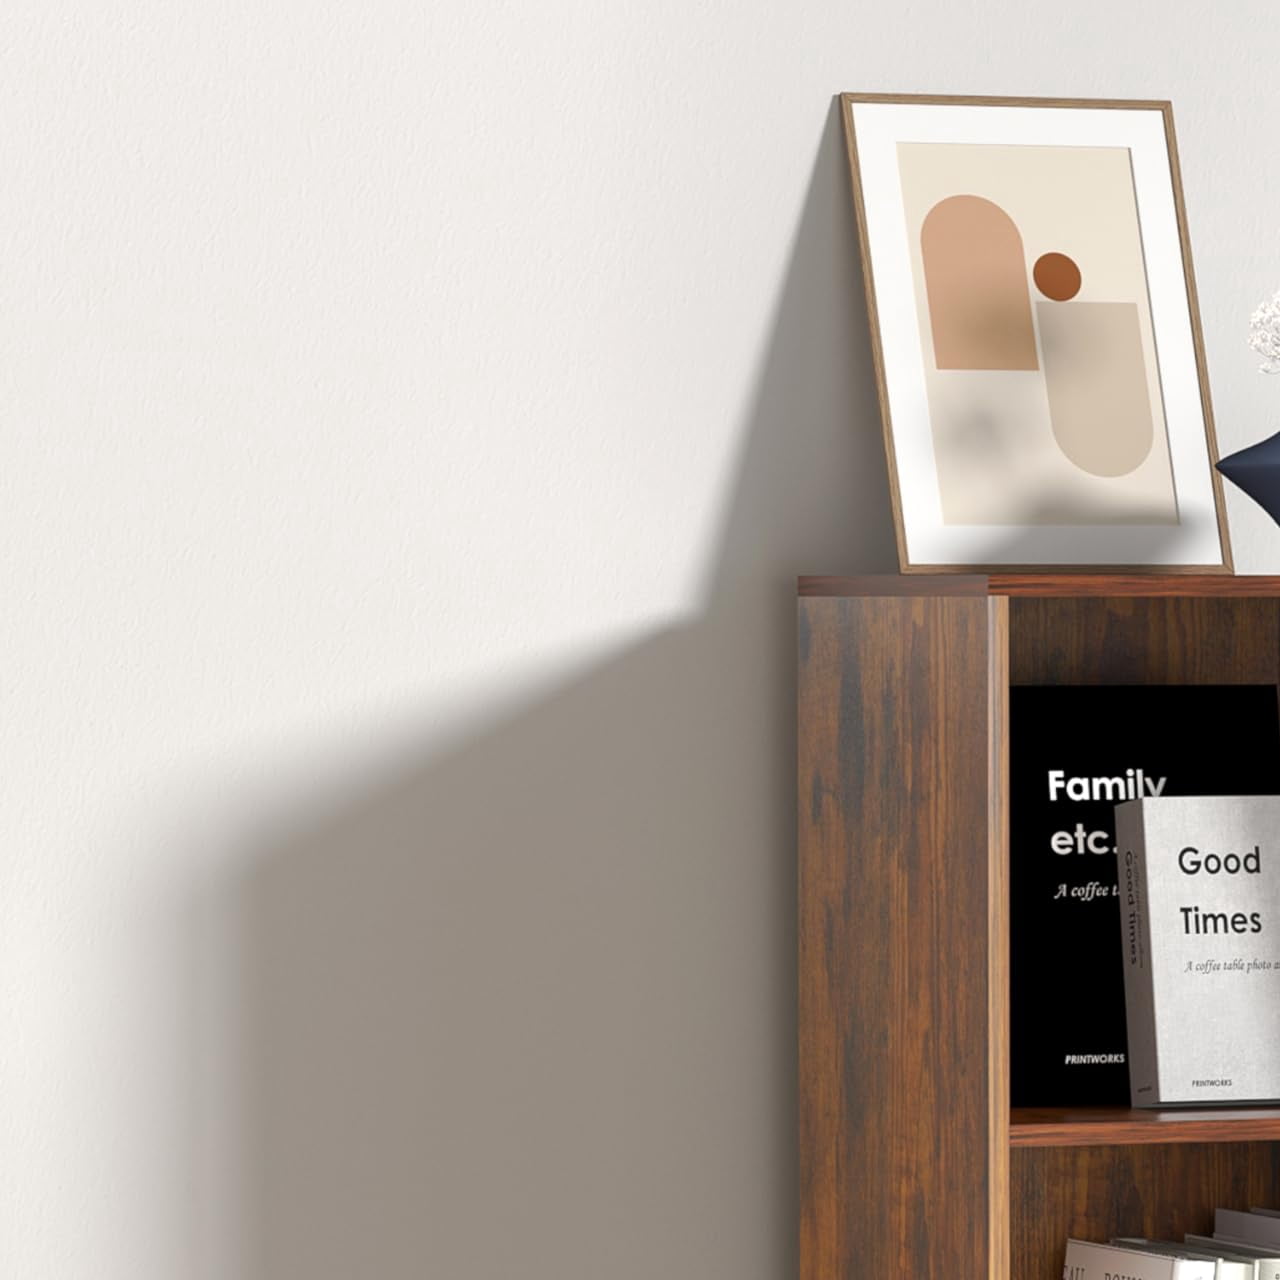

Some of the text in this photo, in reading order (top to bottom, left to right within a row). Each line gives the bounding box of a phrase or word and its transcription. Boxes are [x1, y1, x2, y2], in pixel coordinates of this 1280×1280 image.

[1048, 768, 1167, 800] Family
[1050, 823, 1117, 855] etc.
[1178, 846, 1261, 875] Good
[1054, 883, 1067, 899] A
[1071, 882, 1108, 901] coffee
[1180, 906, 1262, 934] Times
[1184, 961, 1193, 973] A
[1195, 959, 1221, 975] coffee
[1223, 957, 1245, 971] table
[1247, 958, 1271, 974] photo
[1065, 1053, 1125, 1065] PRINTWORKS
[1192, 1079, 1232, 1088] PRINTWORKS
